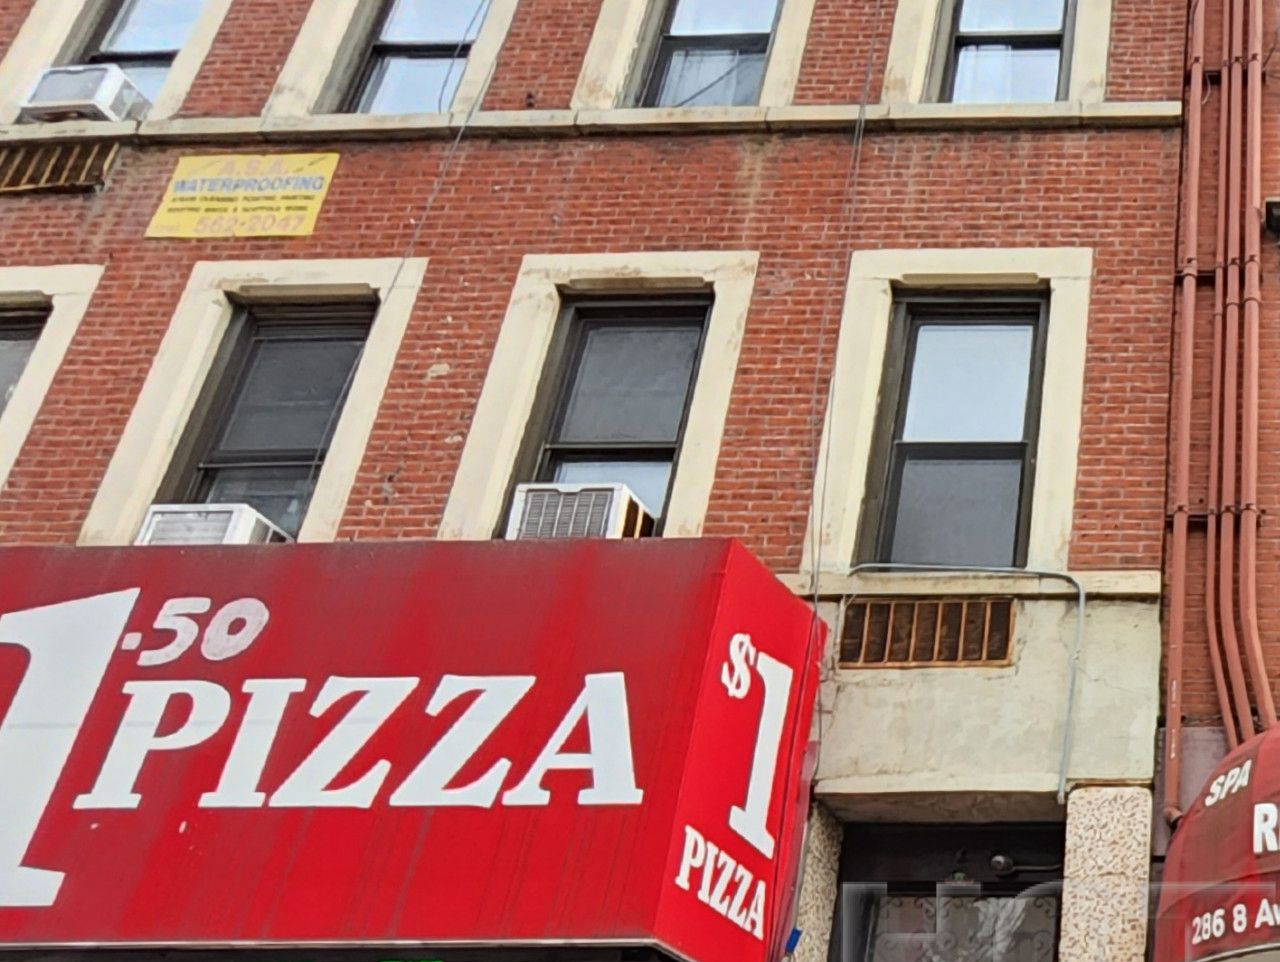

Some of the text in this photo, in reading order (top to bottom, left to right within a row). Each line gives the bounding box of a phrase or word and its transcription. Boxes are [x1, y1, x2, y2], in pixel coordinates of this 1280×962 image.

[173, 175, 326, 193] WATERPROOFING
[72, 672, 644, 810] PIZZA
[1204, 758, 1253, 807] SPA
[674, 824, 766, 942] PIZZA
[1191, 907, 1226, 946] 286
[1232, 903, 1248, 934] 8
